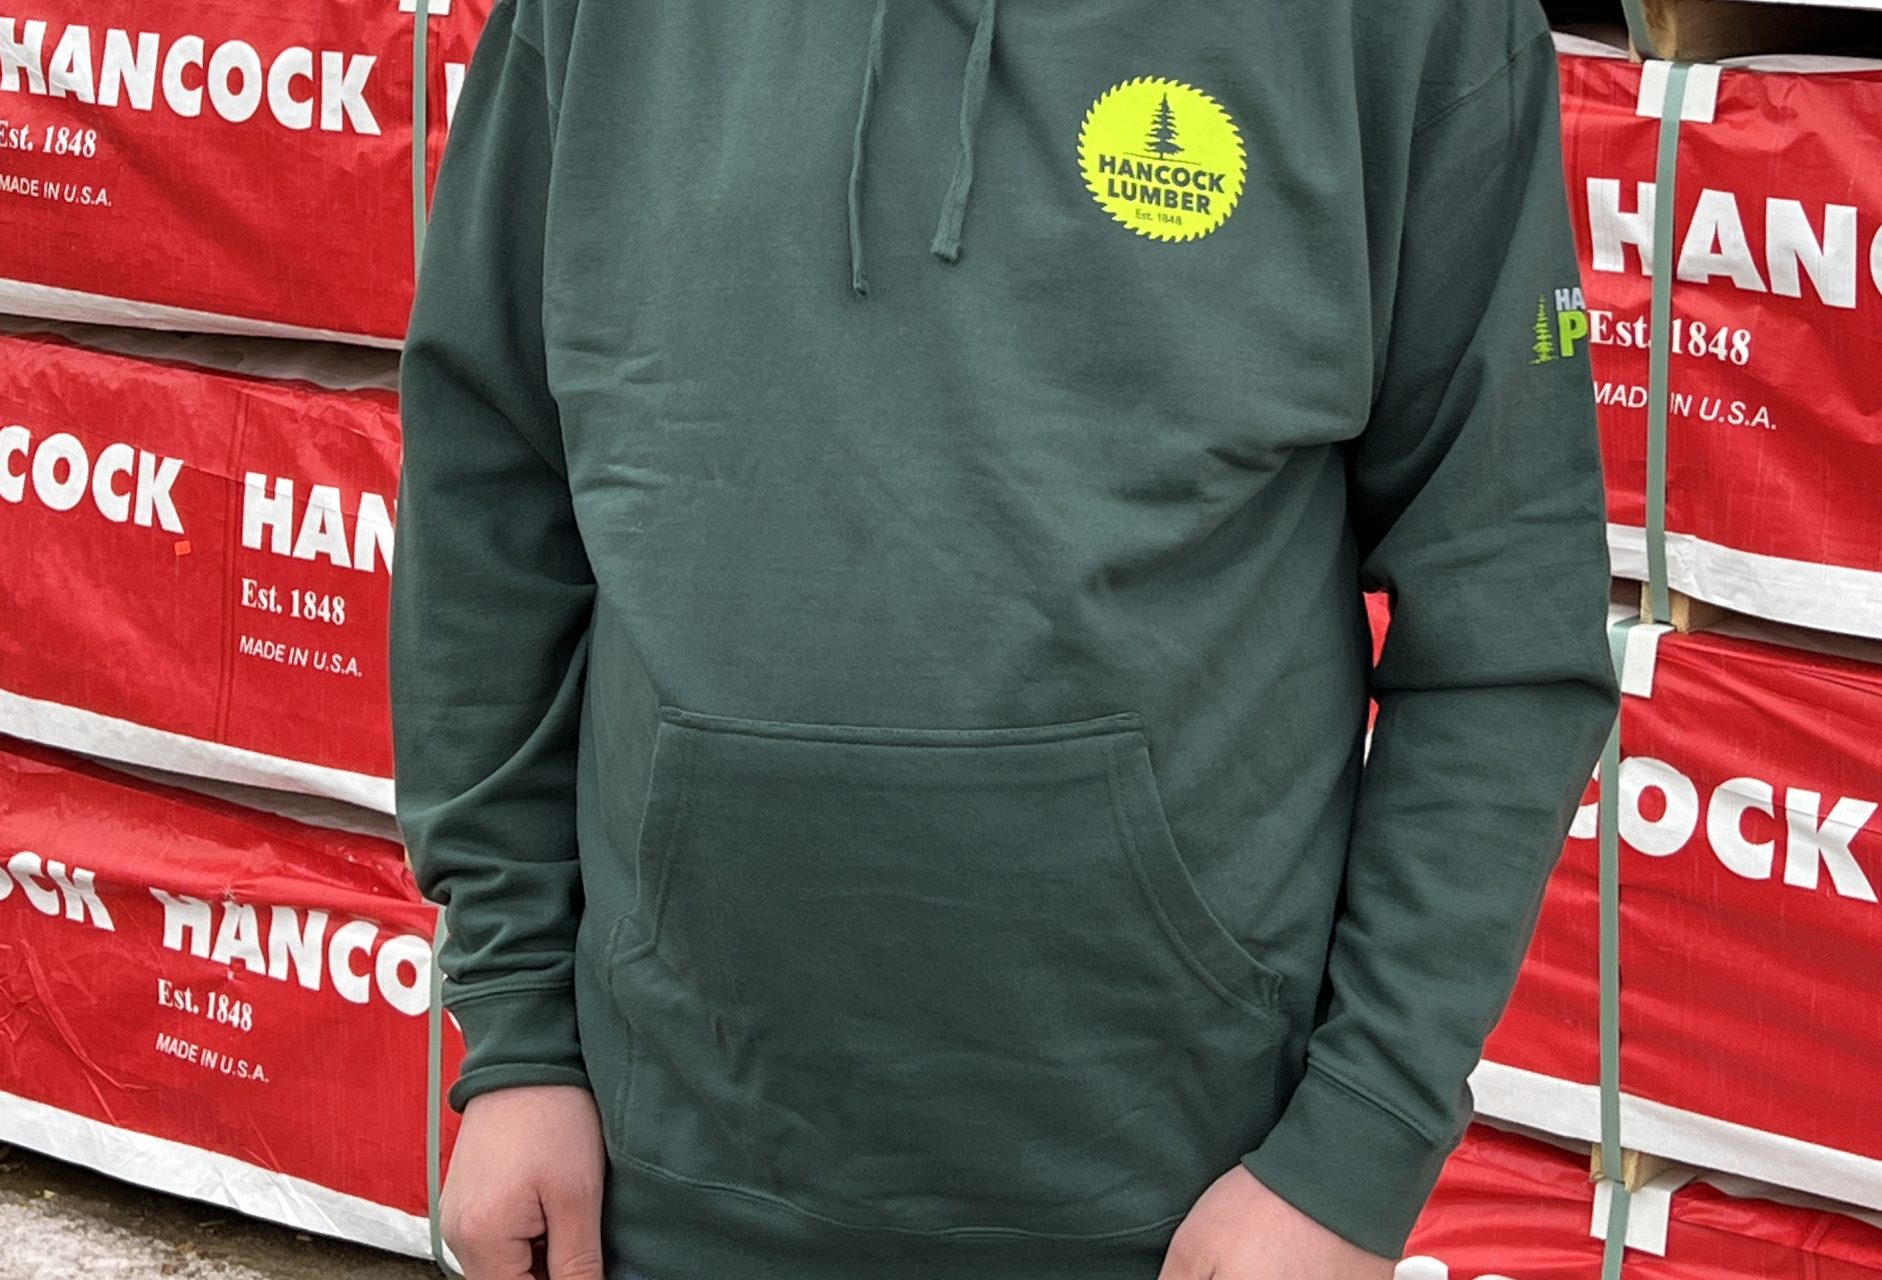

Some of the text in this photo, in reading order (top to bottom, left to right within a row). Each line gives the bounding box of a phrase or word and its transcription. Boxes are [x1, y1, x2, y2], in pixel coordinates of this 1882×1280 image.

[0, 17, 381, 135] HANCOCK
[43, 125, 97, 158] 1848
[0, 174, 112, 207] MADE IN U.S.A.
[1099, 154, 1226, 194] HANCOCK
[1107, 178, 1211, 215] LUMBER
[1671, 318, 1751, 366] 1848
[1669, 392, 1693, 417] IN
[1699, 396, 1777, 430] U.S.A.
[241, 577, 345, 625] Est. 1848
[239, 635, 362, 677] MADE IN U.S.A.
[157, 977, 253, 1032] Est. 1848
[155, 1032, 270, 1083] MADE IN U.S.A.
